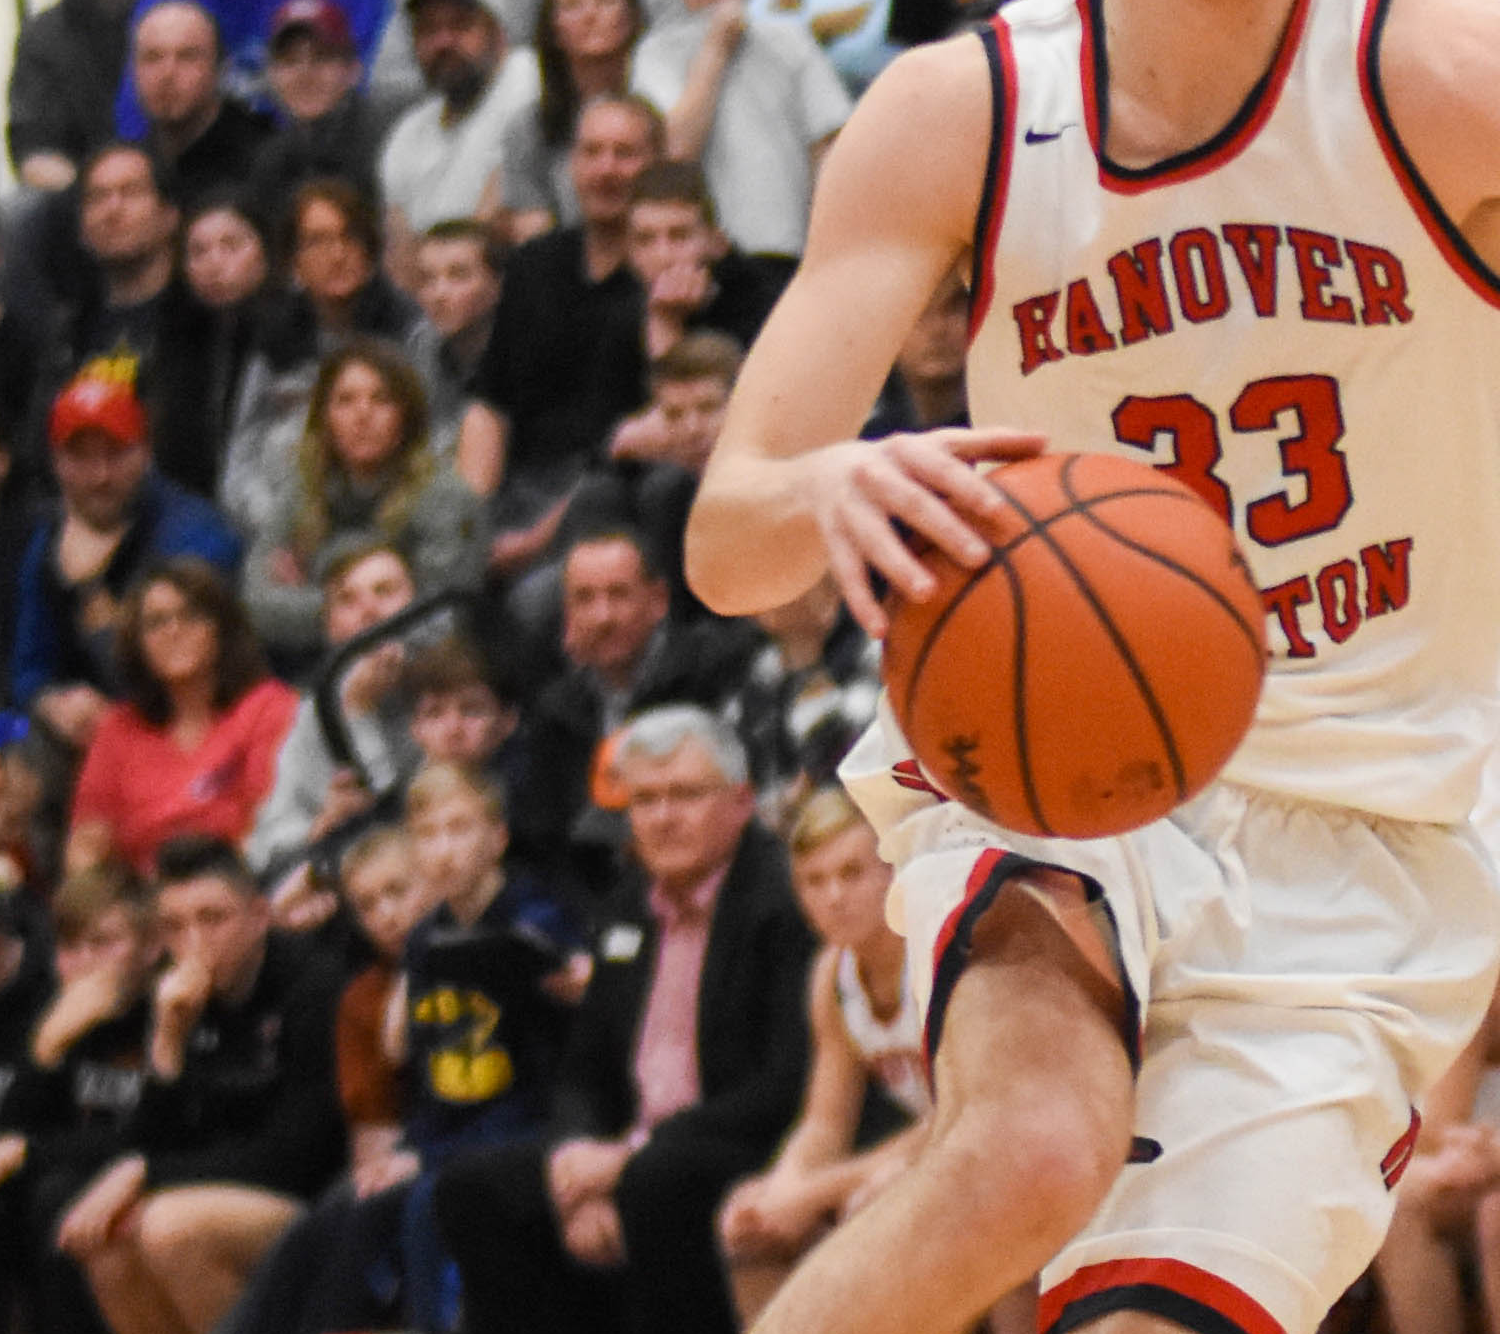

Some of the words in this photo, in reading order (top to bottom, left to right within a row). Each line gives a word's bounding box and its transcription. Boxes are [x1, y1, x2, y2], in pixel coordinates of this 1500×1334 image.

[1013, 223, 1414, 376] HANOVER
[1111, 373, 1355, 548] 33
[1262, 537, 1413, 659] TON
